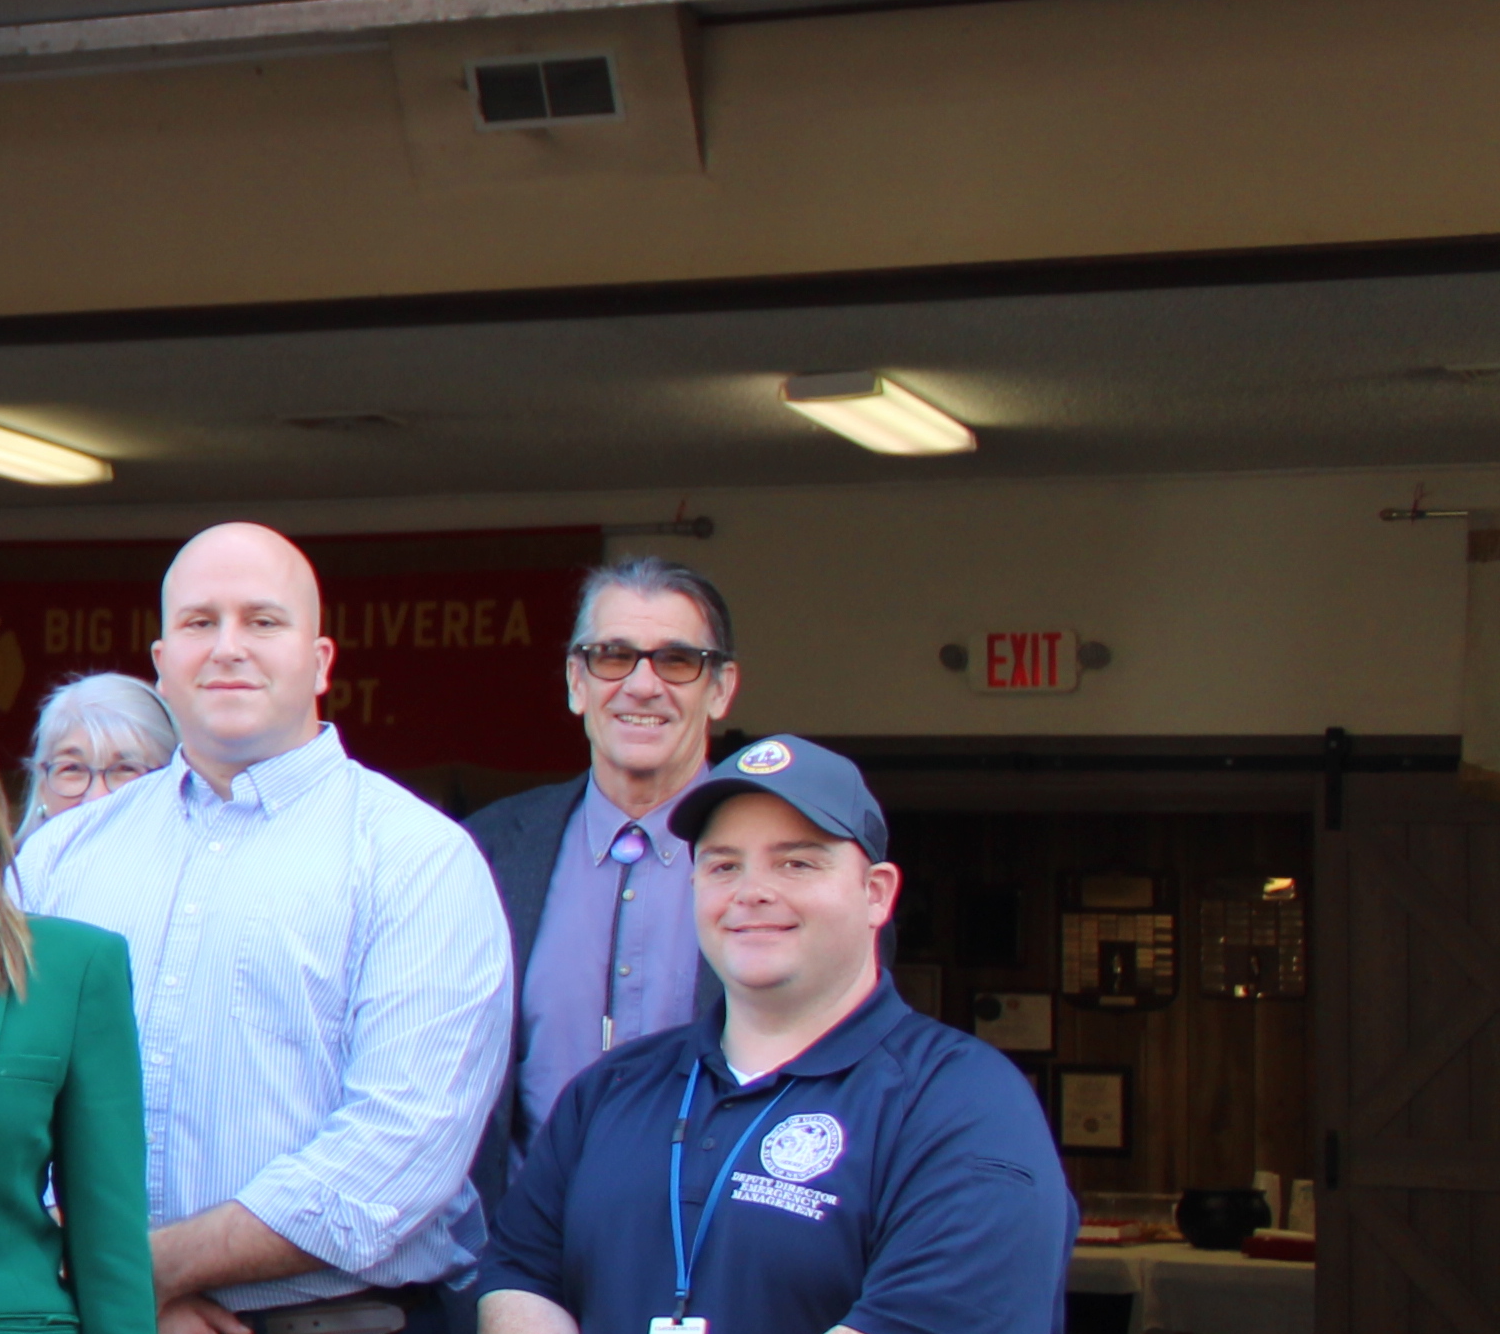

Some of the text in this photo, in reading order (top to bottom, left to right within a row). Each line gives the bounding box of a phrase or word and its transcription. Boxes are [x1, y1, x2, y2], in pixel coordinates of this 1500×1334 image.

[45, 607, 115, 655] BIG
[986, 631, 1063, 688] EXIT
[731, 1171, 839, 1206] DEPUTY DIRECTOR
[731, 1189, 825, 1220] MANAGEMENT
[740, 1182, 821, 1210] EMERGENCY
